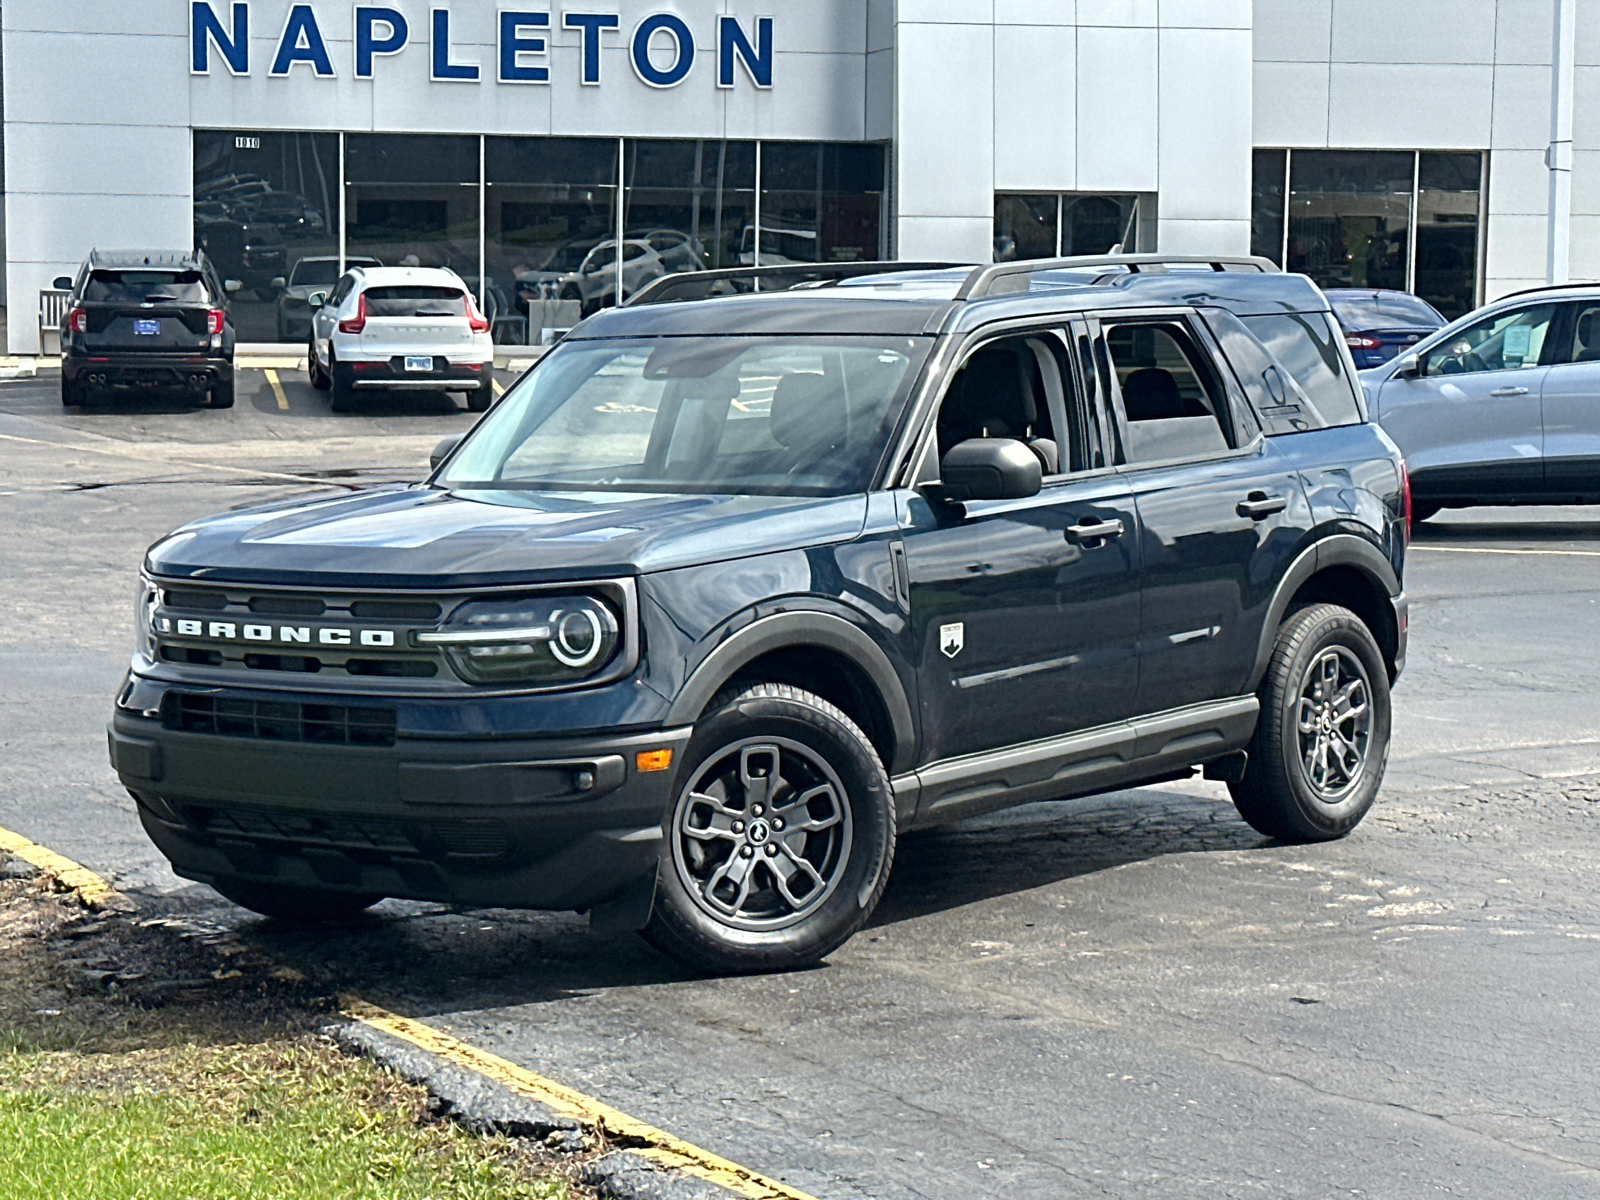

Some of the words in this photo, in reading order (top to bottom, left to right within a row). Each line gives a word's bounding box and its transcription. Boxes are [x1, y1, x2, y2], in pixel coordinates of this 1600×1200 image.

[189, 1, 774, 89] NAPLETON
[236, 137, 259, 148] 1010
[177, 619, 395, 646] BRONCO
